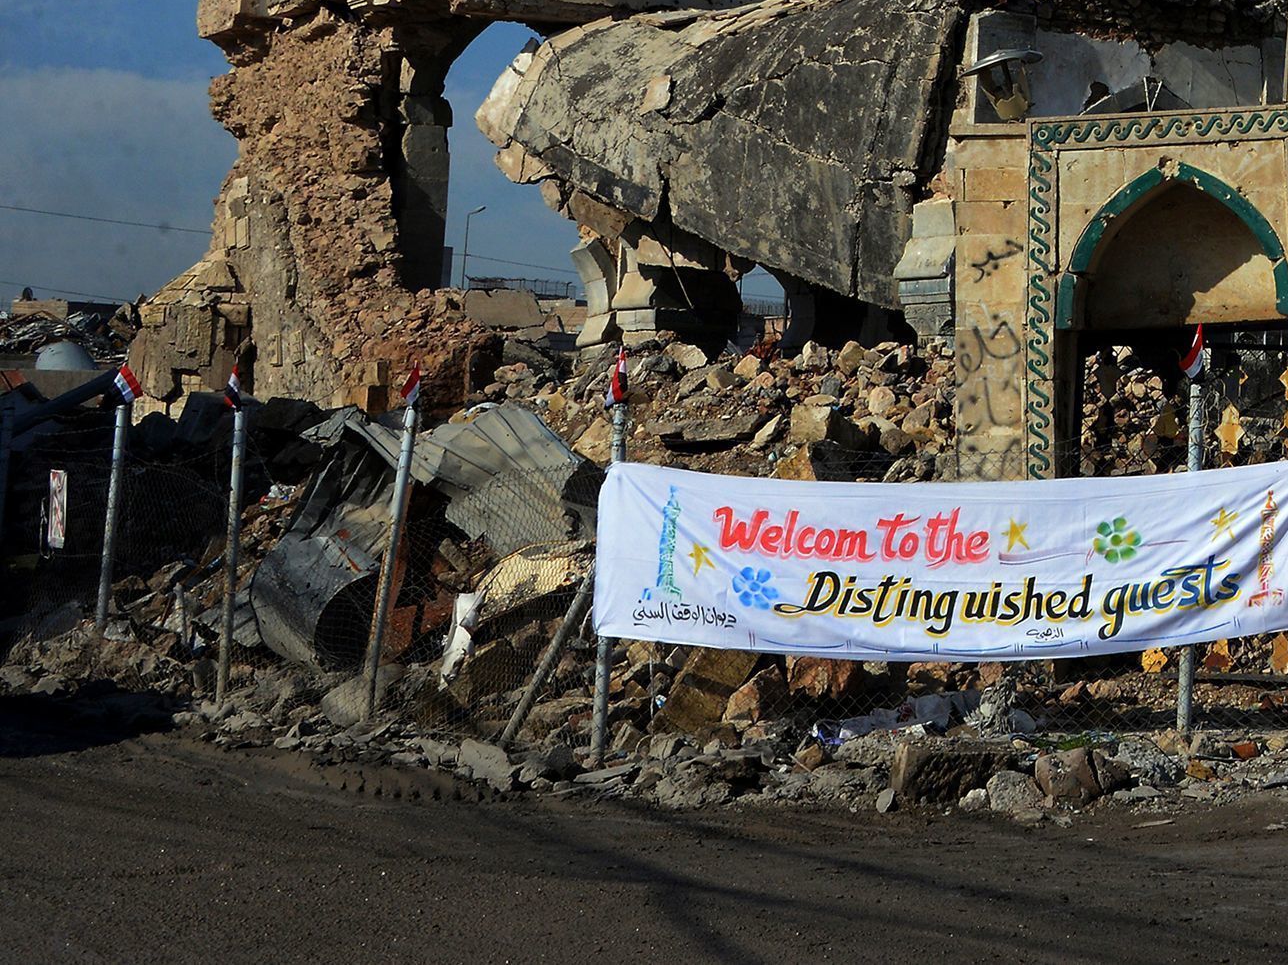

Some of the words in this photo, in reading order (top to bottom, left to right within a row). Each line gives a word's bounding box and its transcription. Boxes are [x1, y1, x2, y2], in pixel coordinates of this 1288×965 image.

[714, 506, 878, 564] Welcom
[875, 513, 922, 562] to
[925, 505, 993, 570] the
[1098, 553, 1243, 641] guests
[632, 599, 672, 628] السني
[671, 602, 707, 628] الوقف
[704, 606, 738, 629] ديوان
